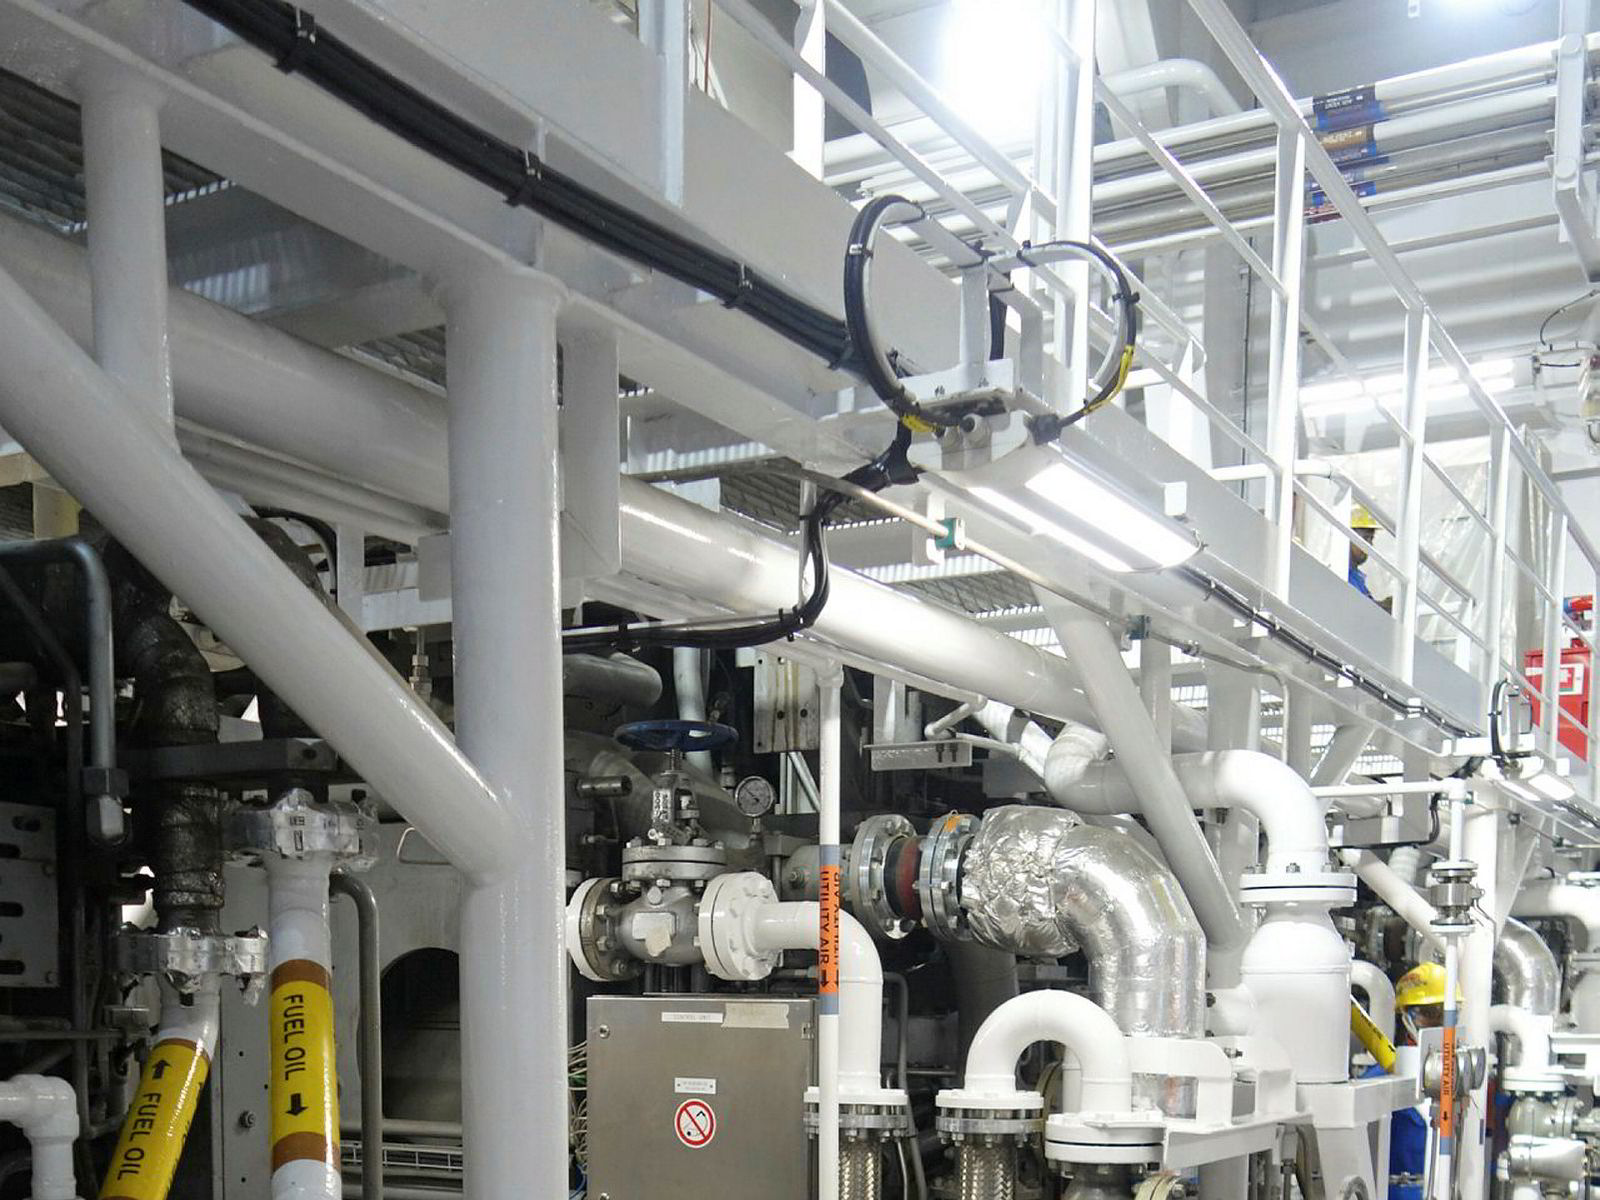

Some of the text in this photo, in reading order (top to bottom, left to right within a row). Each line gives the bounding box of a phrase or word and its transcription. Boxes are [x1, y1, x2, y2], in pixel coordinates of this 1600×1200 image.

[819, 937, 830, 964] AIR
[283, 994, 306, 1081] FUEL OIL
[117, 1093, 162, 1181] FUEL OIL
